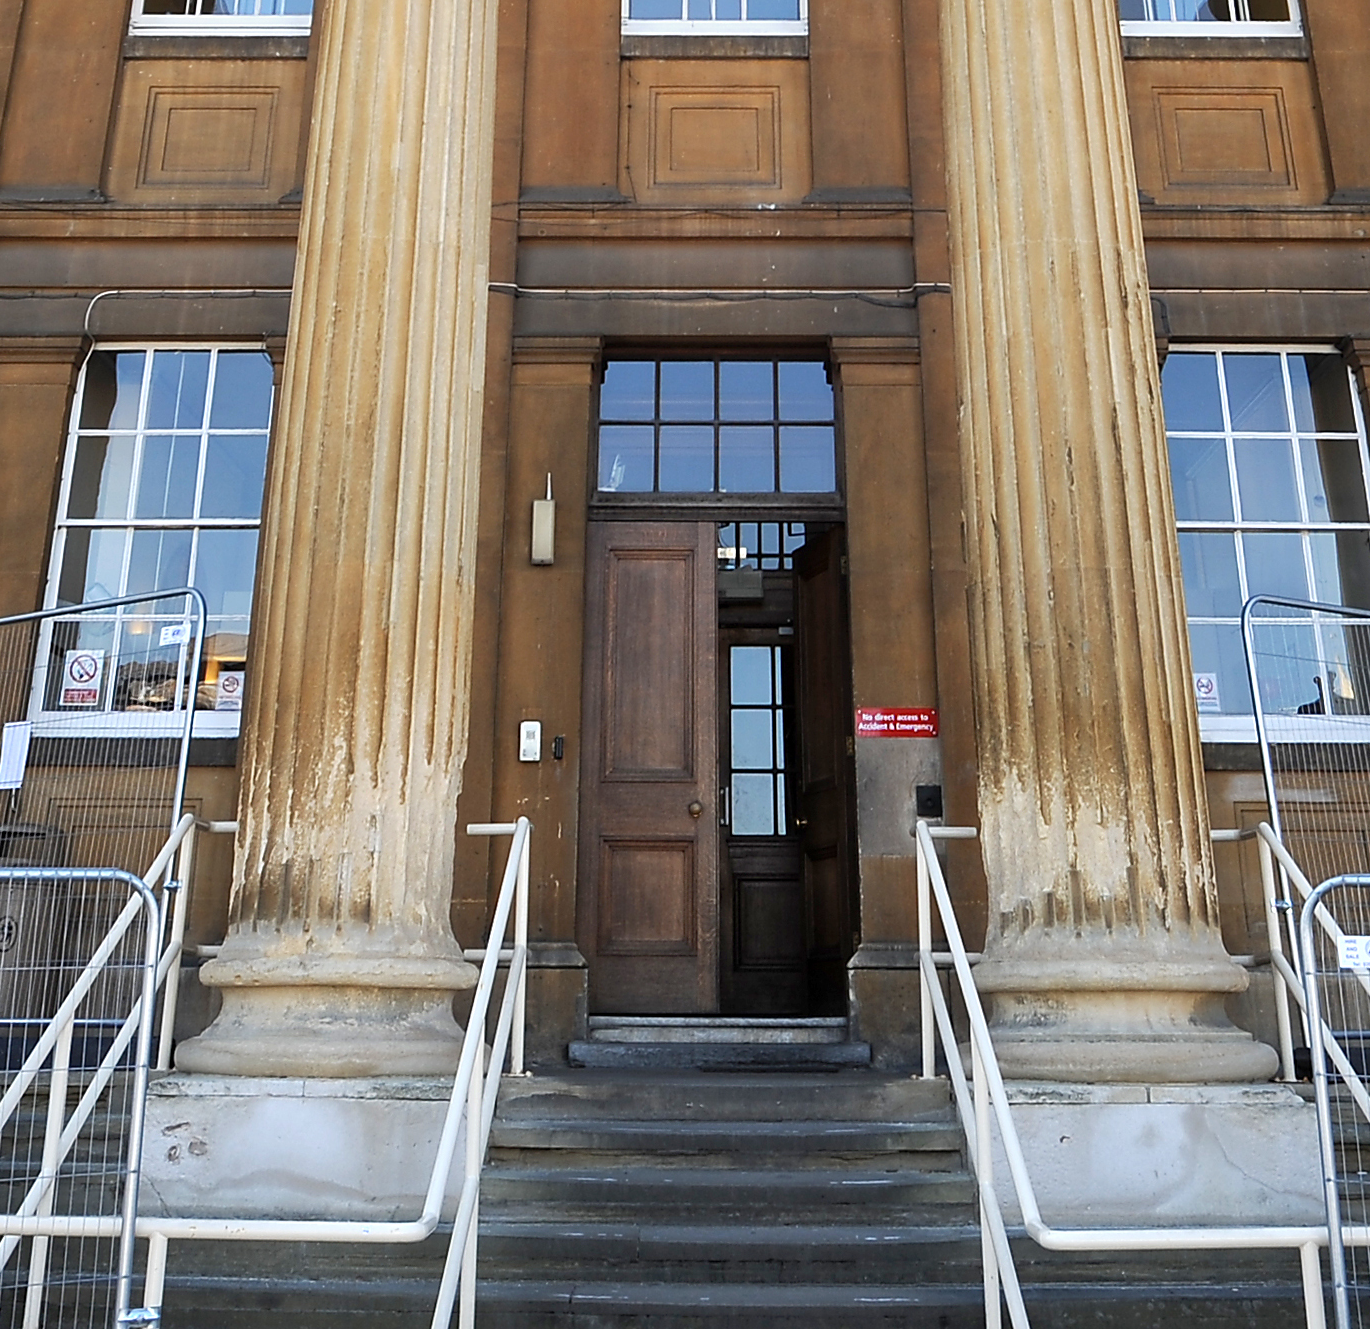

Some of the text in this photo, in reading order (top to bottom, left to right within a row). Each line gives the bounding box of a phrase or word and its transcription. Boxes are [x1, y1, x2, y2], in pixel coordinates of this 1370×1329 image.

[862, 713, 873, 721] No
[874, 713, 895, 721] direct
[858, 722, 888, 730] Accident
[896, 722, 934, 732] Emergency
